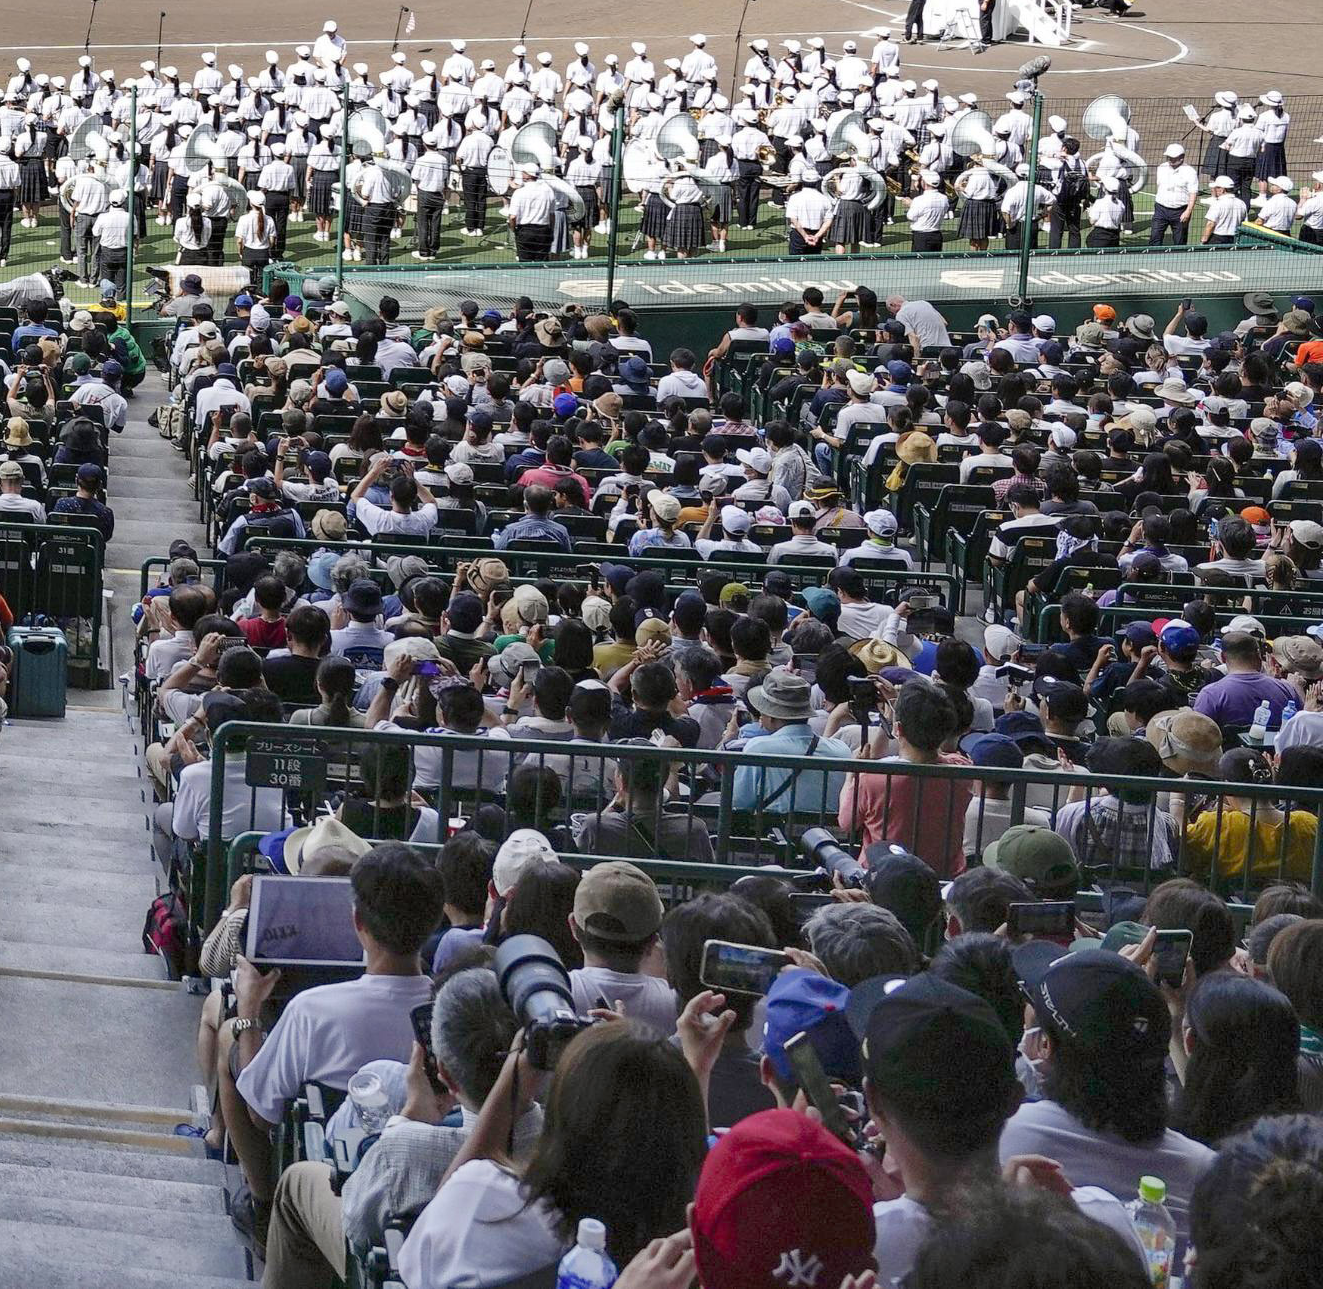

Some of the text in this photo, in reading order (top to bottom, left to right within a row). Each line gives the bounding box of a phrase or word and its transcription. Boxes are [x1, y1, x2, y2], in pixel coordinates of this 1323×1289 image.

[1016, 268, 1241, 286] idemitsu
[635, 277, 858, 295] idemitsu
[256, 741, 320, 754] ブリーズシート
[273, 759, 301, 773] 11段
[269, 773, 302, 787] 30番
